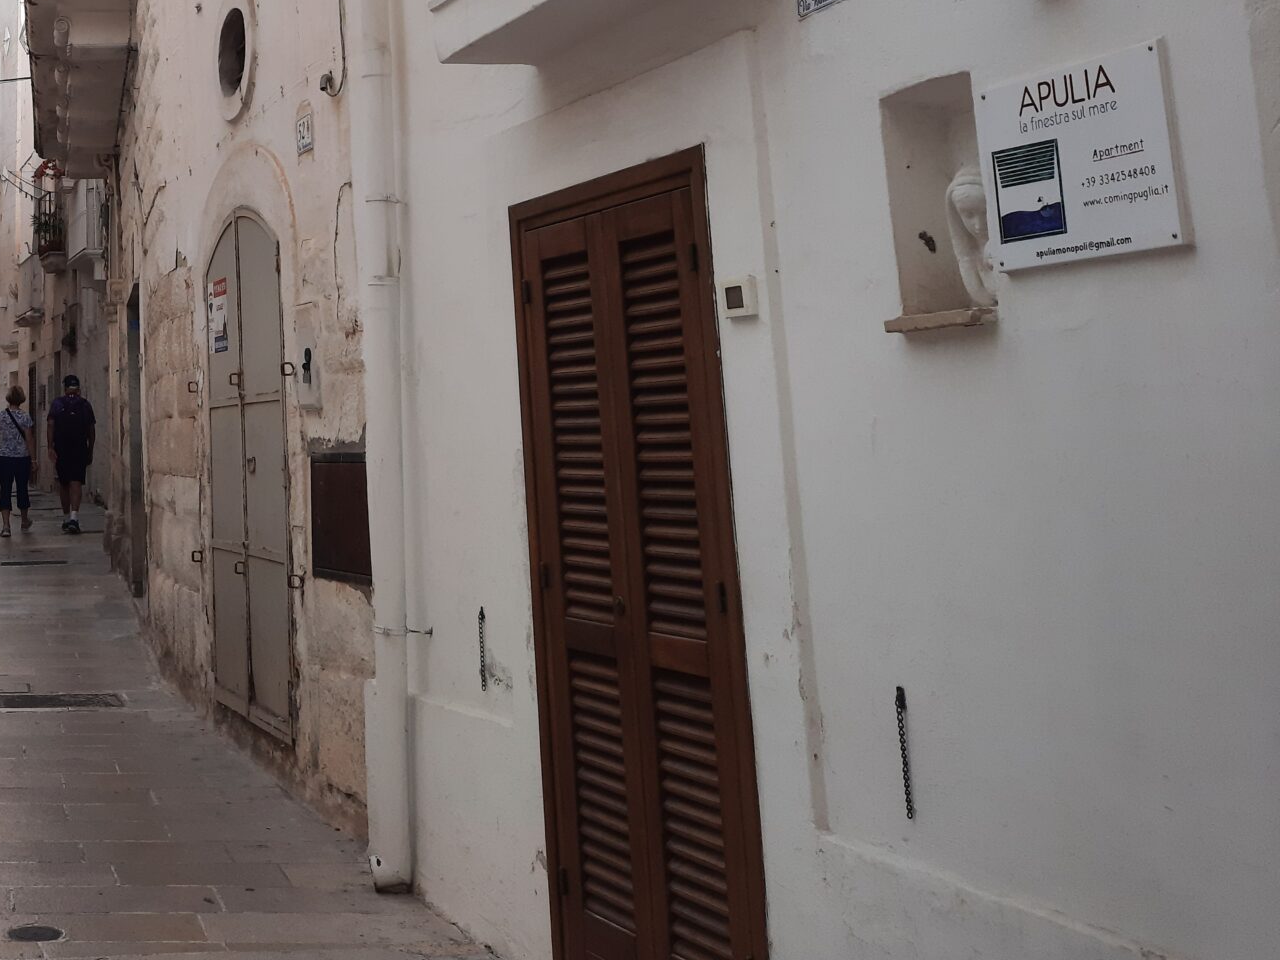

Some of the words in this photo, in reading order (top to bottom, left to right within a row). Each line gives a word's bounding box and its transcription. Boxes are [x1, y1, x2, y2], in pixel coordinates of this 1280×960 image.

[1019, 65, 1116, 116] APULIA
[1019, 120, 1028, 134] la
[1030, 113, 1070, 131] finestra
[1071, 108, 1086, 121] sul
[1088, 100, 1118, 118] mare
[1092, 139, 1144, 161] Apartment
[1081, 176, 1096, 188] +39
[1099, 165, 1156, 186] 3342548408
[1083, 184, 1169, 208] www.comingpuglia.it
[1035, 236, 1132, 259] apuliamonopoli@gmail.com
